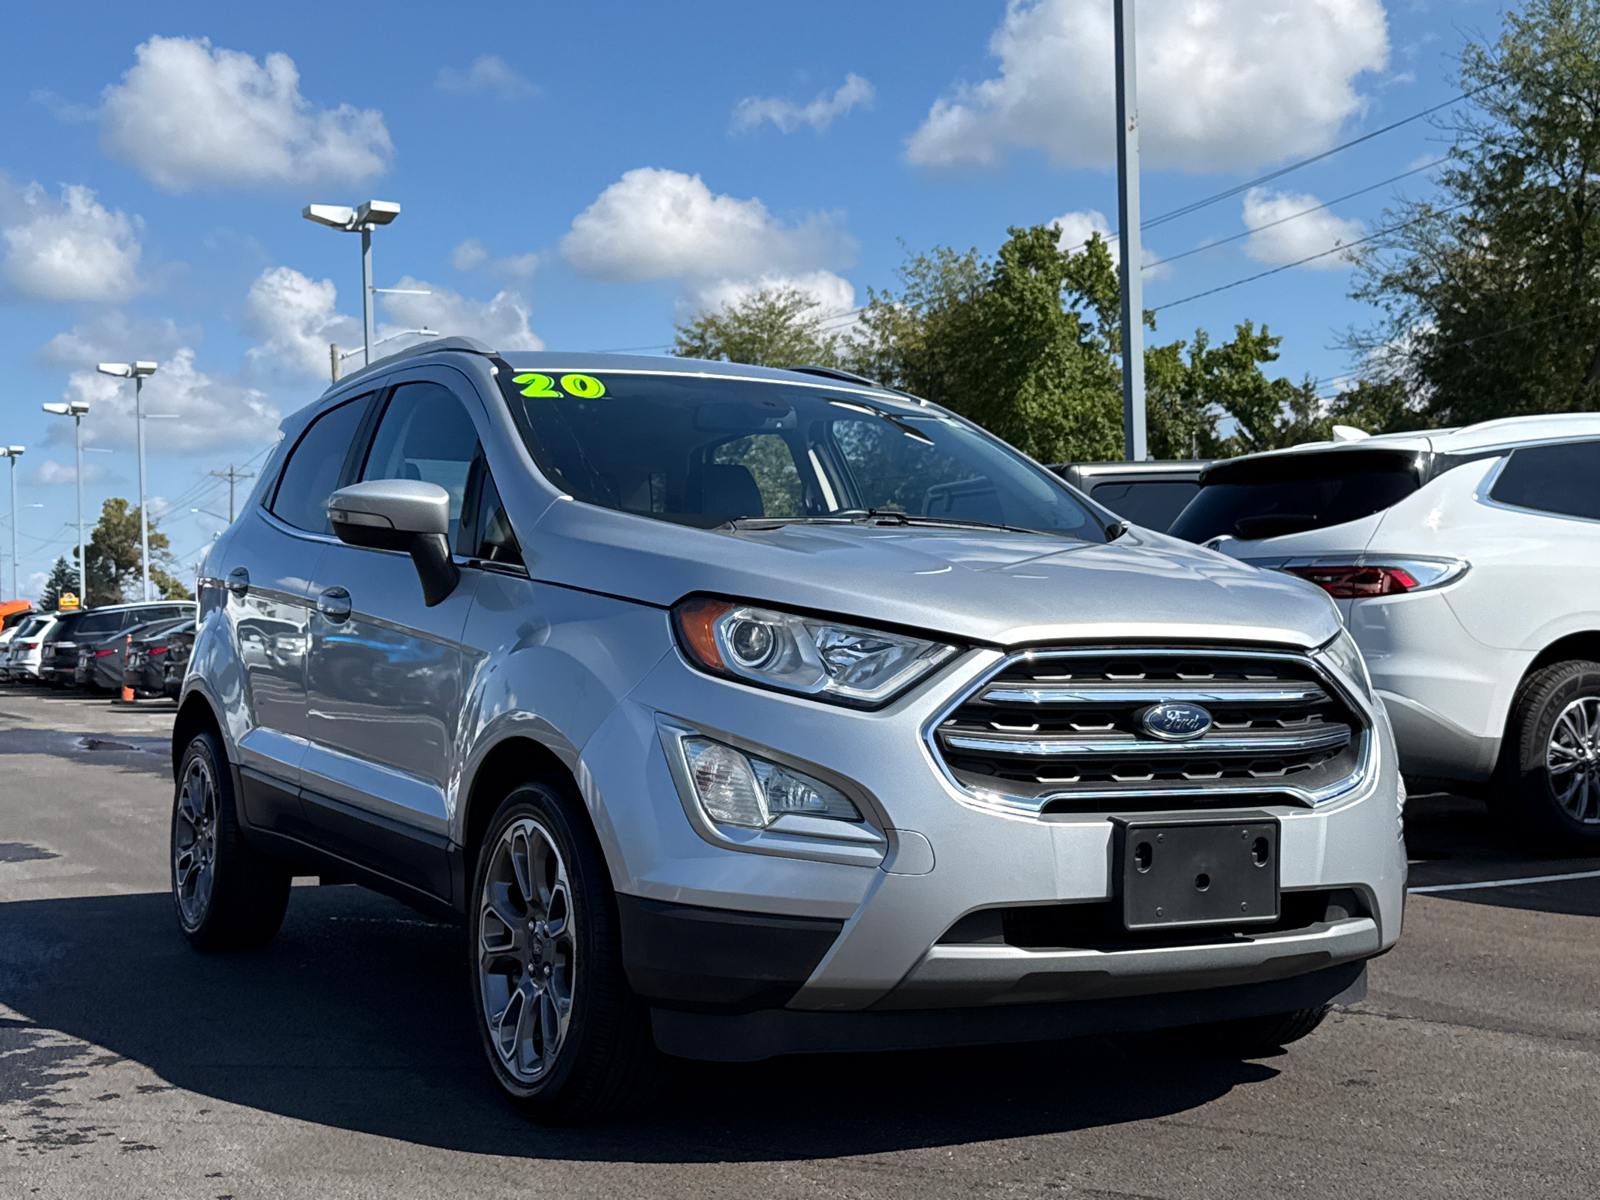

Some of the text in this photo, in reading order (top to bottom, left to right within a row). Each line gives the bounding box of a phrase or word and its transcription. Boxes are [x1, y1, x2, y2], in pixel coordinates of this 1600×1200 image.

[512, 373, 605, 398] 20
[1163, 710, 1200, 729] Ford
[1538, 687, 1566, 738] KELLY
